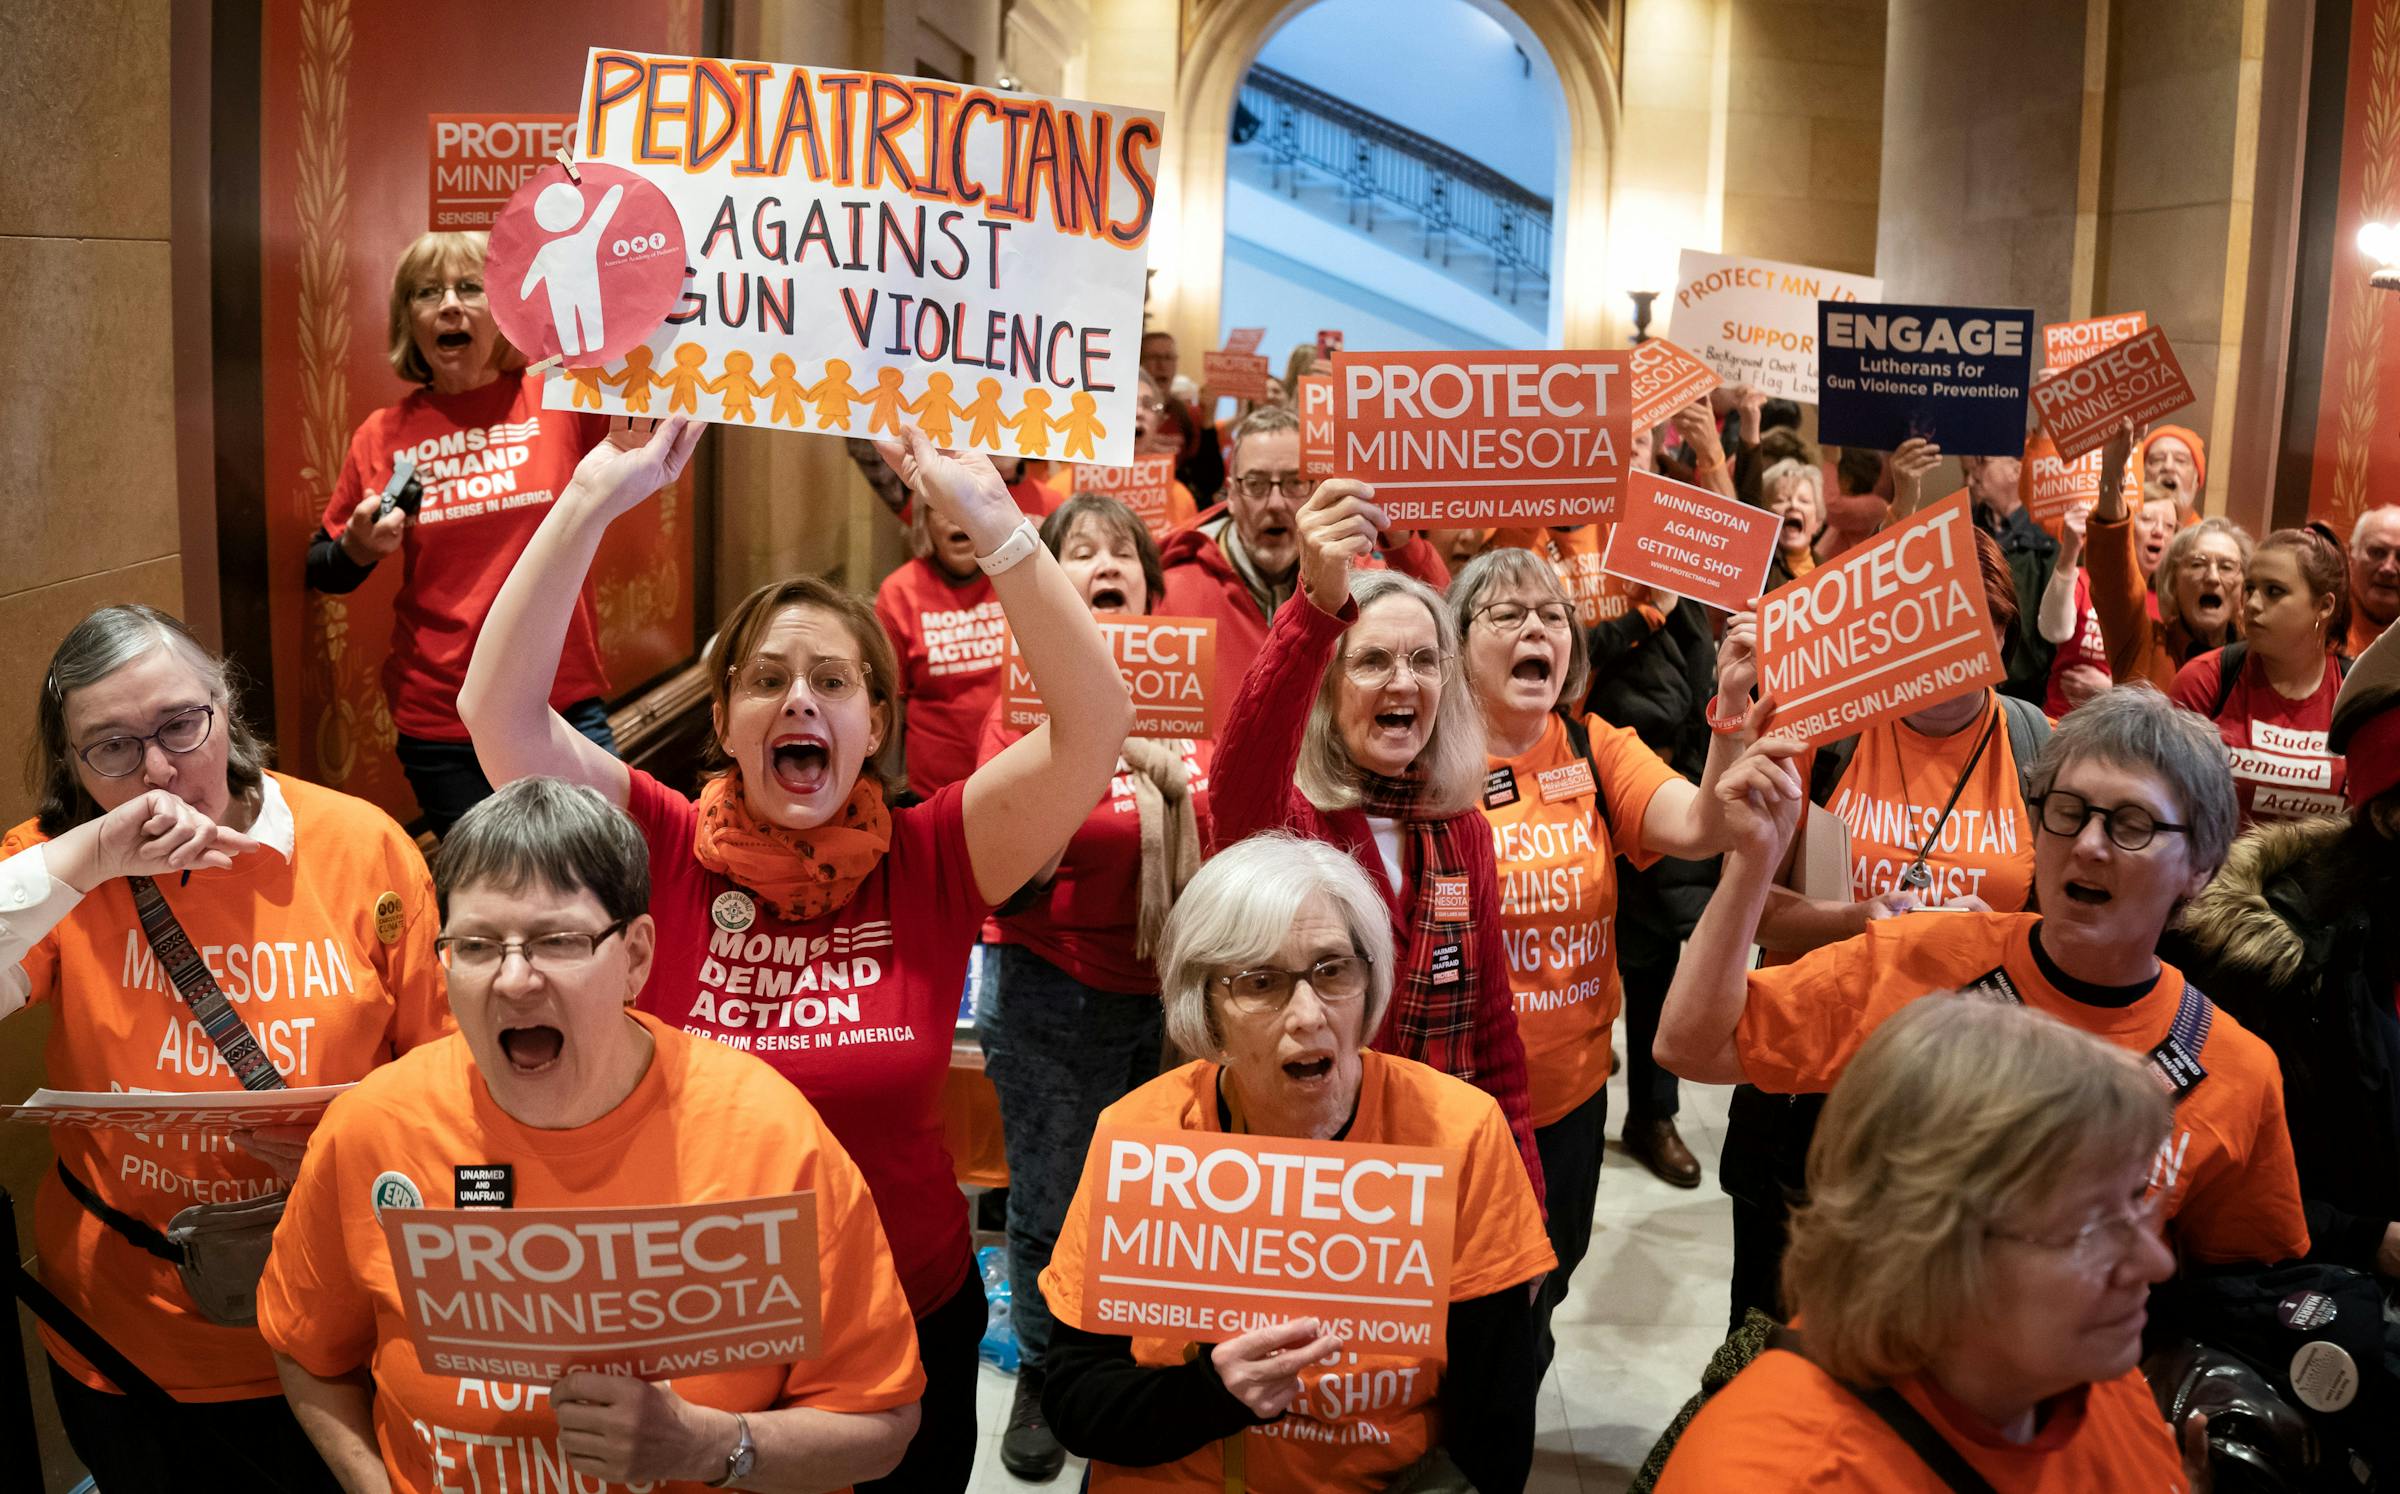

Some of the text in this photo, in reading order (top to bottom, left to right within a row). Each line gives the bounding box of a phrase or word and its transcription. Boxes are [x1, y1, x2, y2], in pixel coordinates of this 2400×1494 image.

[437, 122, 577, 159] PROTE
[586, 50, 1159, 249] PEDIATRICIANS
[437, 164, 545, 193] MINNE
[701, 195, 1012, 289] AGAINST
[1679, 267, 1774, 308] PROTECT
[1781, 275, 1820, 298] MN
[664, 268, 1117, 392] GUN VIOLENCE
[1722, 321, 1814, 355] SUPPOR
[1827, 312, 2024, 357] ENGAGE
[2047, 316, 2142, 349] PROTECT
[1860, 356, 1985, 378] Lutherans for
[2049, 342, 2113, 365] MINNE
[1346, 363, 1619, 419] PROTECT
[1631, 356, 1697, 400] ESOTA
[1752, 368, 1783, 395] Flag
[1793, 377, 1818, 394] Law
[1827, 374, 2020, 399] Gun Violence Prevention
[2036, 333, 2160, 415] PROTECT
[2049, 363, 2177, 437] MINNESOTA
[393, 427, 488, 466] MOMS
[414, 445, 530, 486] EMAND
[1346, 428, 1618, 472] MINNESOTA
[2032, 447, 2139, 481] PROTET
[420, 470, 517, 508] CTION
[1074, 459, 1172, 490] PROTECT
[2033, 470, 2139, 500] MINNESA
[418, 509, 444, 525] GUN
[445, 501, 485, 520] SENSE
[486, 498, 500, 513] IN
[501, 489, 554, 510] AMERICA
[1112, 487, 1168, 509] ESOTA
[1381, 496, 1616, 521] SIBLE GUN LAWS NOW!
[1653, 491, 1750, 534] MINNESOTAN
[1663, 520, 1729, 550] AGAINST
[1637, 536, 1742, 581] GETTING SHOT
[1650, 559, 1721, 589] WWW.PROTECTMN.ORG
[1762, 507, 1960, 654] PROTECT
[923, 620, 1004, 647] DEMAN
[928, 636, 1004, 664] ACTIO
[1763, 579, 1977, 694] MINNESOTA
[1010, 663, 1204, 700] MSOTA
[1840, 692, 1885, 725] GUN
[1884, 674, 1936, 708] LAWS
[1937, 652, 1991, 691] NOW!
[1010, 711, 1204, 733] SENS WS NOW!
[2261, 730, 2323, 751] Stude
[1538, 762, 1587, 784] PROTECT
[2228, 752, 2322, 782] Demand
[1833, 788, 2017, 855] MINNESOTAN
[2261, 793, 2336, 815] Action
[1493, 810, 1597, 863] ESOTA
[1435, 882, 1468, 896] OTECT
[1500, 866, 1584, 915] AINST
[1852, 855, 1987, 906] AGNST
[1435, 896, 1469, 907] NESOTA
[708, 928, 830, 966] MOMS
[1433, 945, 1458, 957] ARMED
[1549, 915, 1612, 970] SHOT
[122, 928, 355, 1005] MESOTAN
[698, 955, 882, 998] DEMAND
[688, 989, 861, 1029] ACTION
[1512, 976, 1600, 1013] TMN.ORG
[156, 1015, 316, 1078] AGNST
[717, 1033, 751, 1051] GUN
[756, 1034, 811, 1051] SENSE
[815, 1033, 832, 1048] IN
[837, 1025, 915, 1047] AMERICA
[2156, 1050, 2188, 1087] UNAFRAID
[2169, 1040, 2201, 1076] UNARMED
[9, 1108, 311, 1123] PROTECT
[121, 1154, 294, 1205] PROTECTMN
[460, 1169, 505, 1180] UNARMED
[475, 1181, 490, 1189] AND
[1106, 1140, 1443, 1226] PROTECT
[460, 1191, 505, 1201] UNAFRAID
[401, 1208, 798, 1284] PROTECT
[1101, 1215, 1434, 1287] MINNESOTA
[416, 1275, 802, 1335] MINNESOTA
[1097, 1298, 1213, 1331] SENSIBLE
[1218, 1309, 1276, 1333] GUN
[1358, 1319, 1431, 1345] NOW!
[2294, 1295, 2323, 1326] WARREN
[434, 1352, 567, 1380] SENSIBLE
[640, 1349, 719, 1377] LAWS
[726, 1335, 806, 1363] NOW!
[1319, 1367, 1421, 1420] SHOT
[412, 1419, 608, 1494] GETTIN
